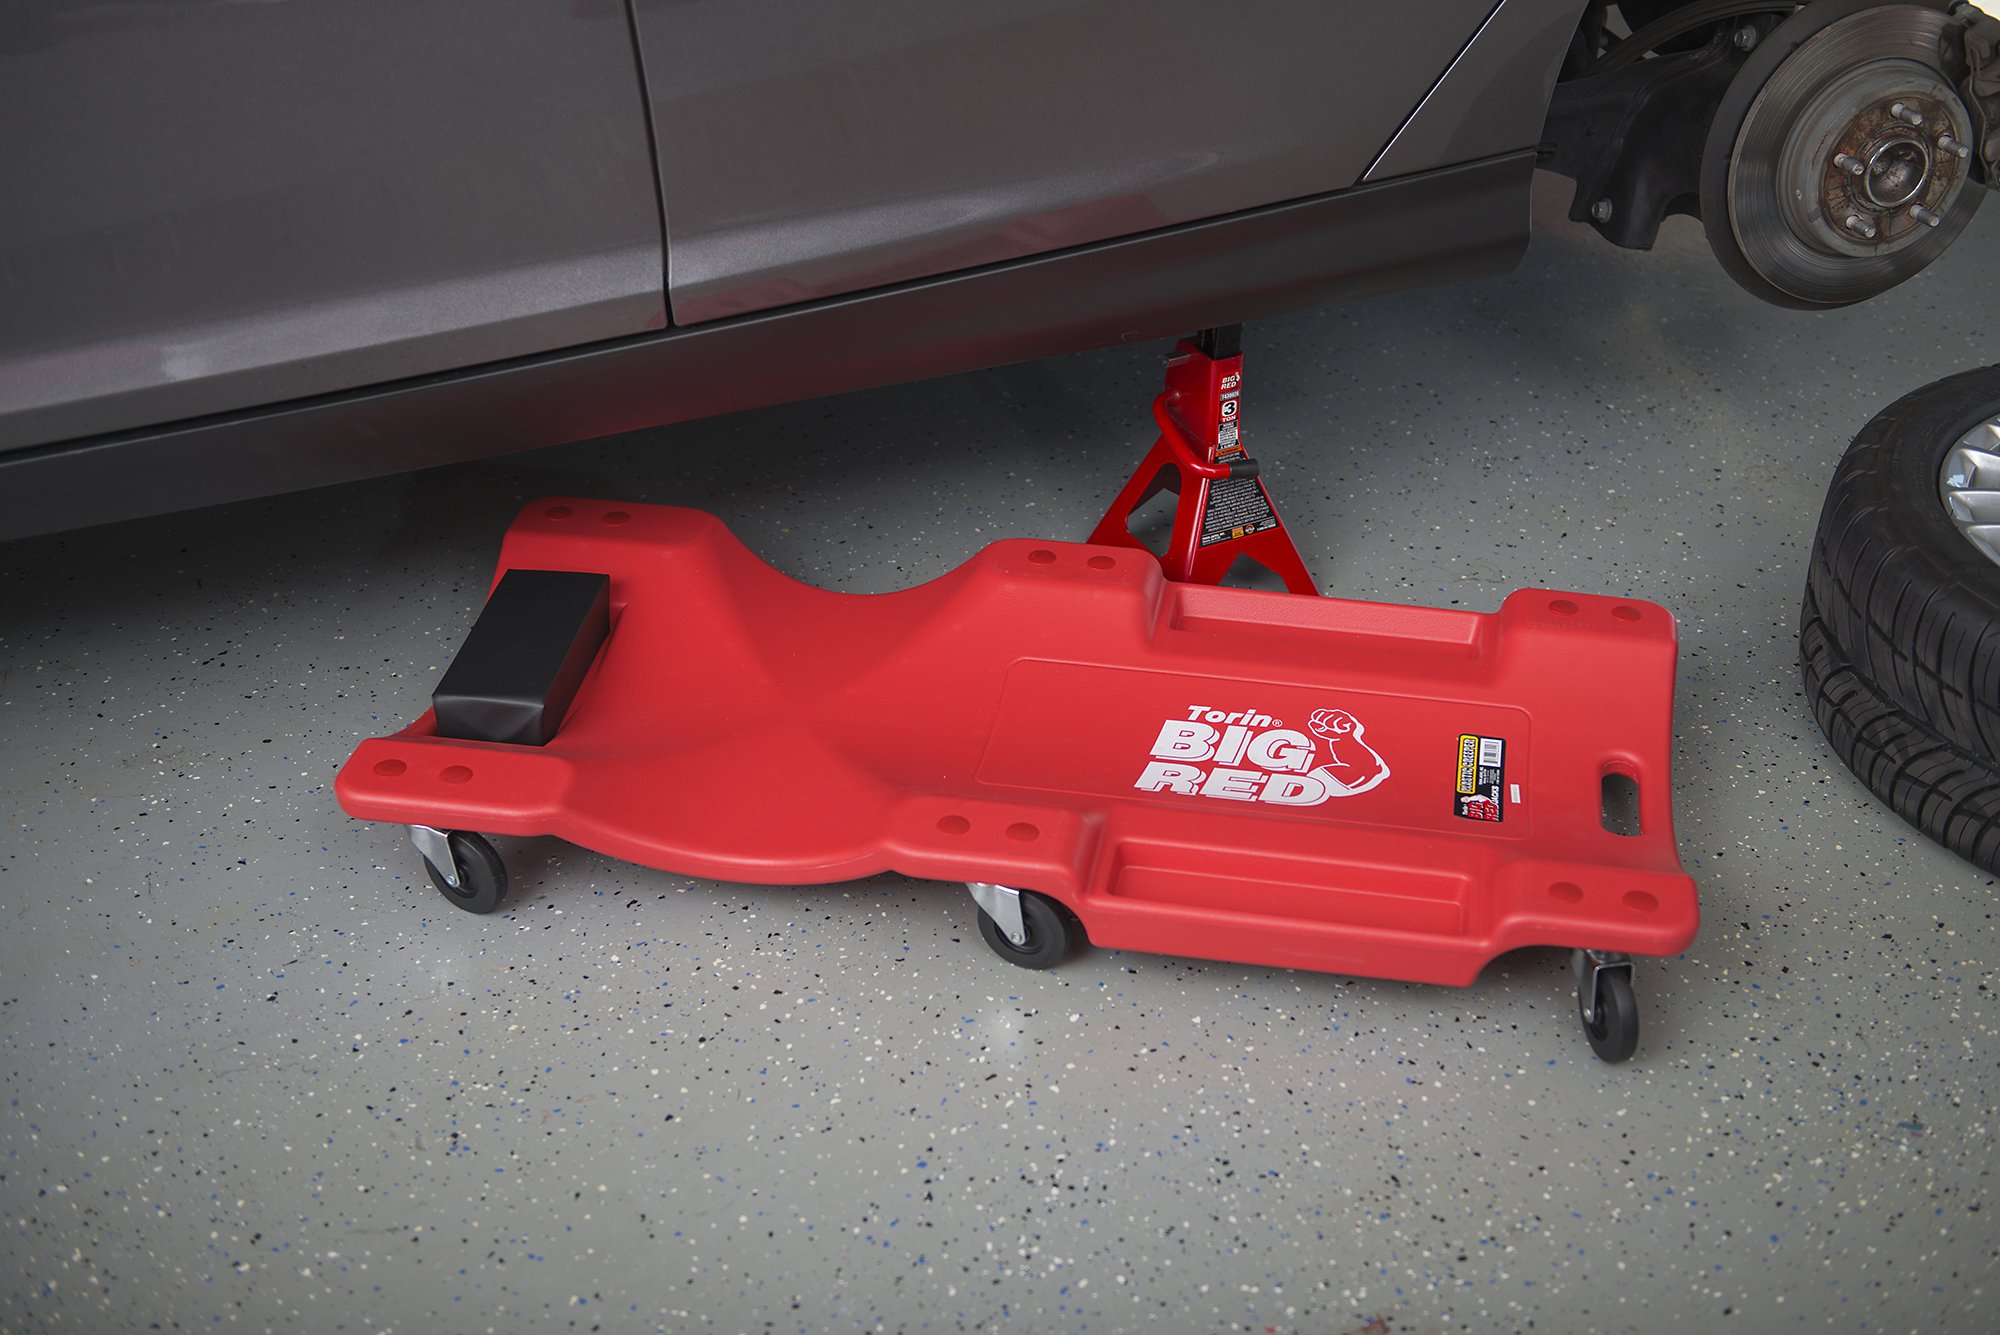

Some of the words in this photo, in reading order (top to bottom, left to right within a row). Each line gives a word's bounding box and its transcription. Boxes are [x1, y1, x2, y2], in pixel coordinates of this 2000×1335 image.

[1221, 381, 1237, 390] RED
[1222, 375, 1235, 384] BIG
[1223, 401, 1236, 416] 3
[1222, 415, 1237, 423] TON
[1150, 719, 1316, 773] BIG
[1462, 739, 1475, 767] CREEPER
[1133, 761, 1331, 807] RED
[1460, 768, 1473, 792] PLASTIC
